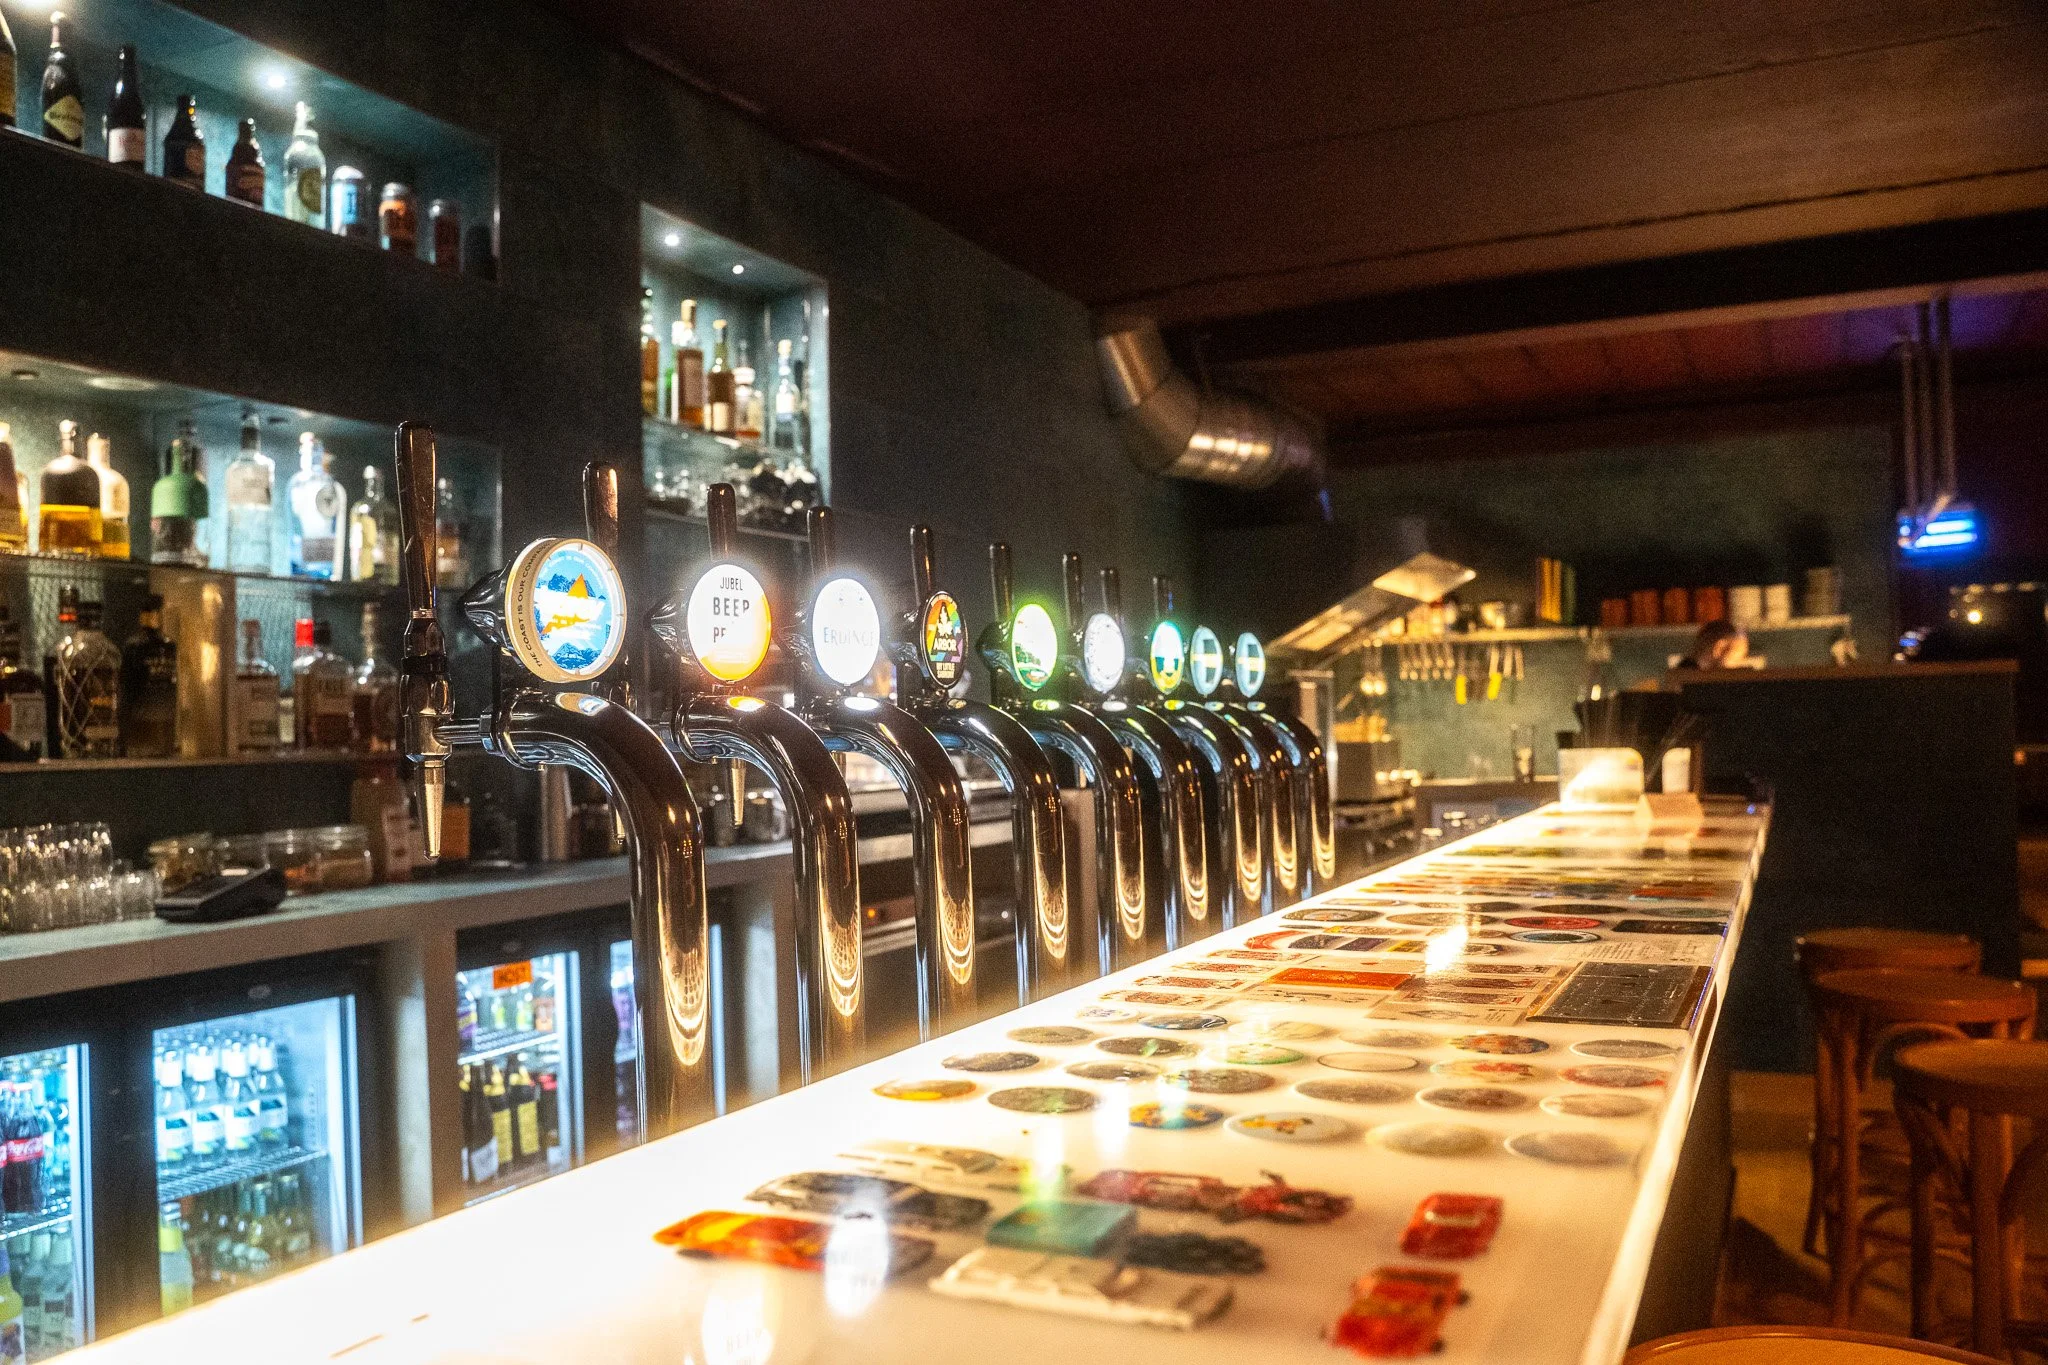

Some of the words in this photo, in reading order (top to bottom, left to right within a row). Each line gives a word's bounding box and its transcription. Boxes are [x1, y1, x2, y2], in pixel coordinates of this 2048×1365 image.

[517, 580, 526, 602] OUR
[720, 577, 744, 591] JUBEL
[517, 604, 523, 615] IS
[517, 618, 532, 650] COAST
[933, 638, 957, 652] ARBOR
[530, 651, 543, 667] THE
